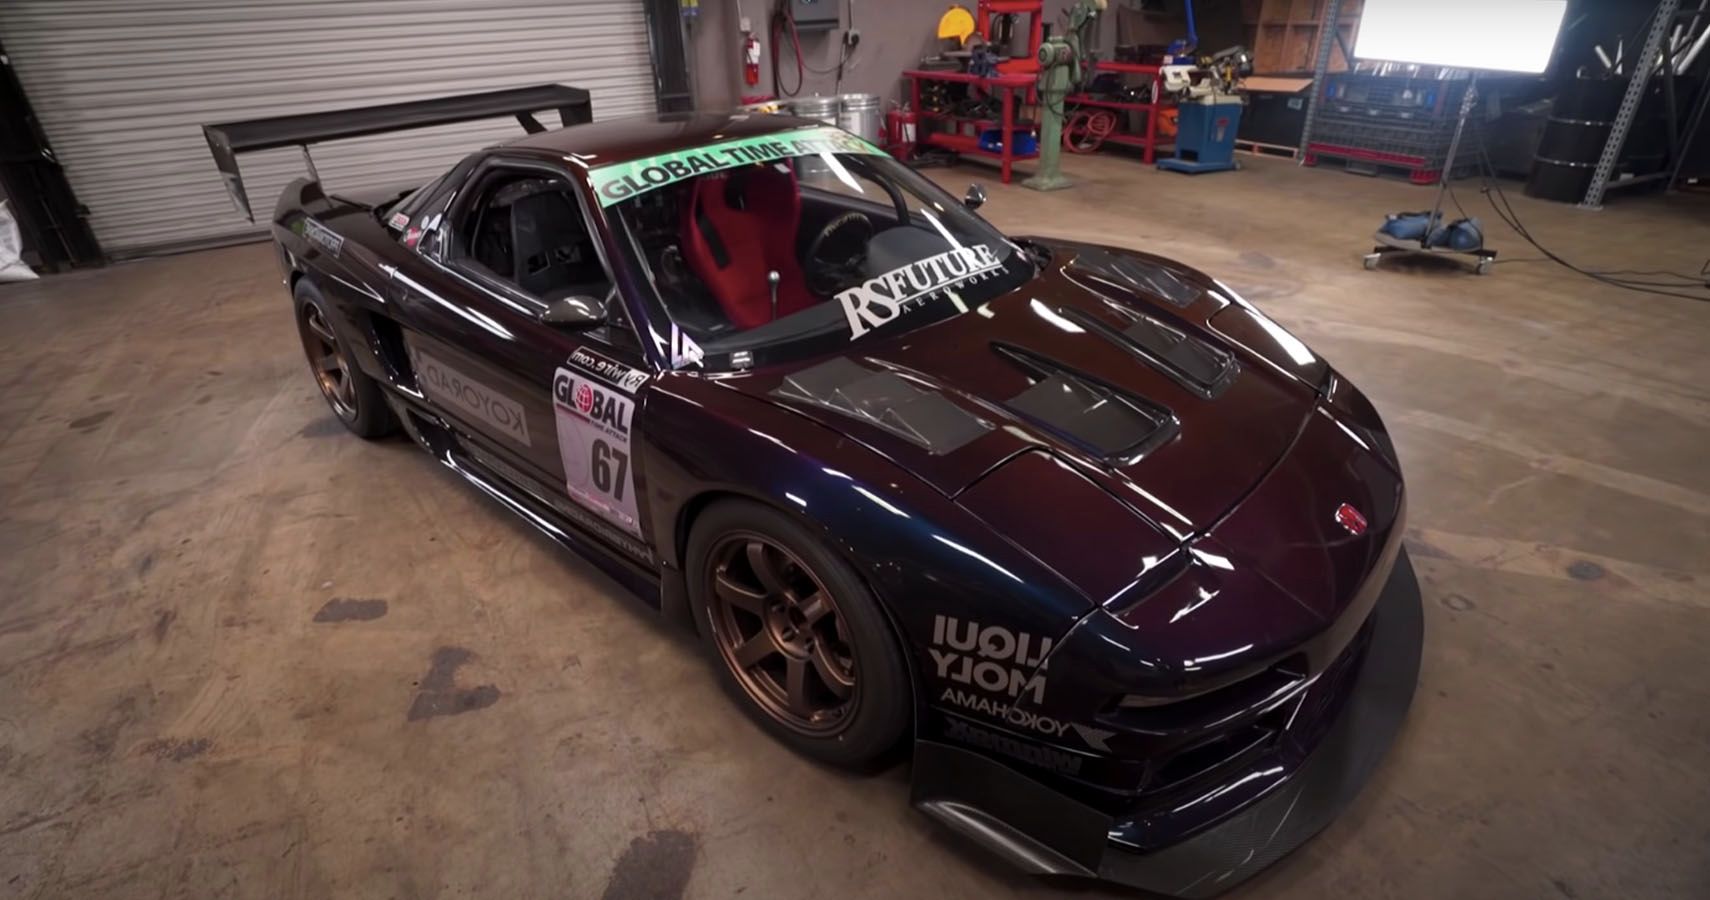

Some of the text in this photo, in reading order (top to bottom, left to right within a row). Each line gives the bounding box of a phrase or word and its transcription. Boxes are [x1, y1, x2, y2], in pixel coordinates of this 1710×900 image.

[600, 153, 724, 200] GLOBAL
[726, 140, 794, 166] TIME
[902, 267, 1010, 315] AEROWORKS
[554, 374, 628, 435] GLOBAL
[591, 438, 628, 502] 67
